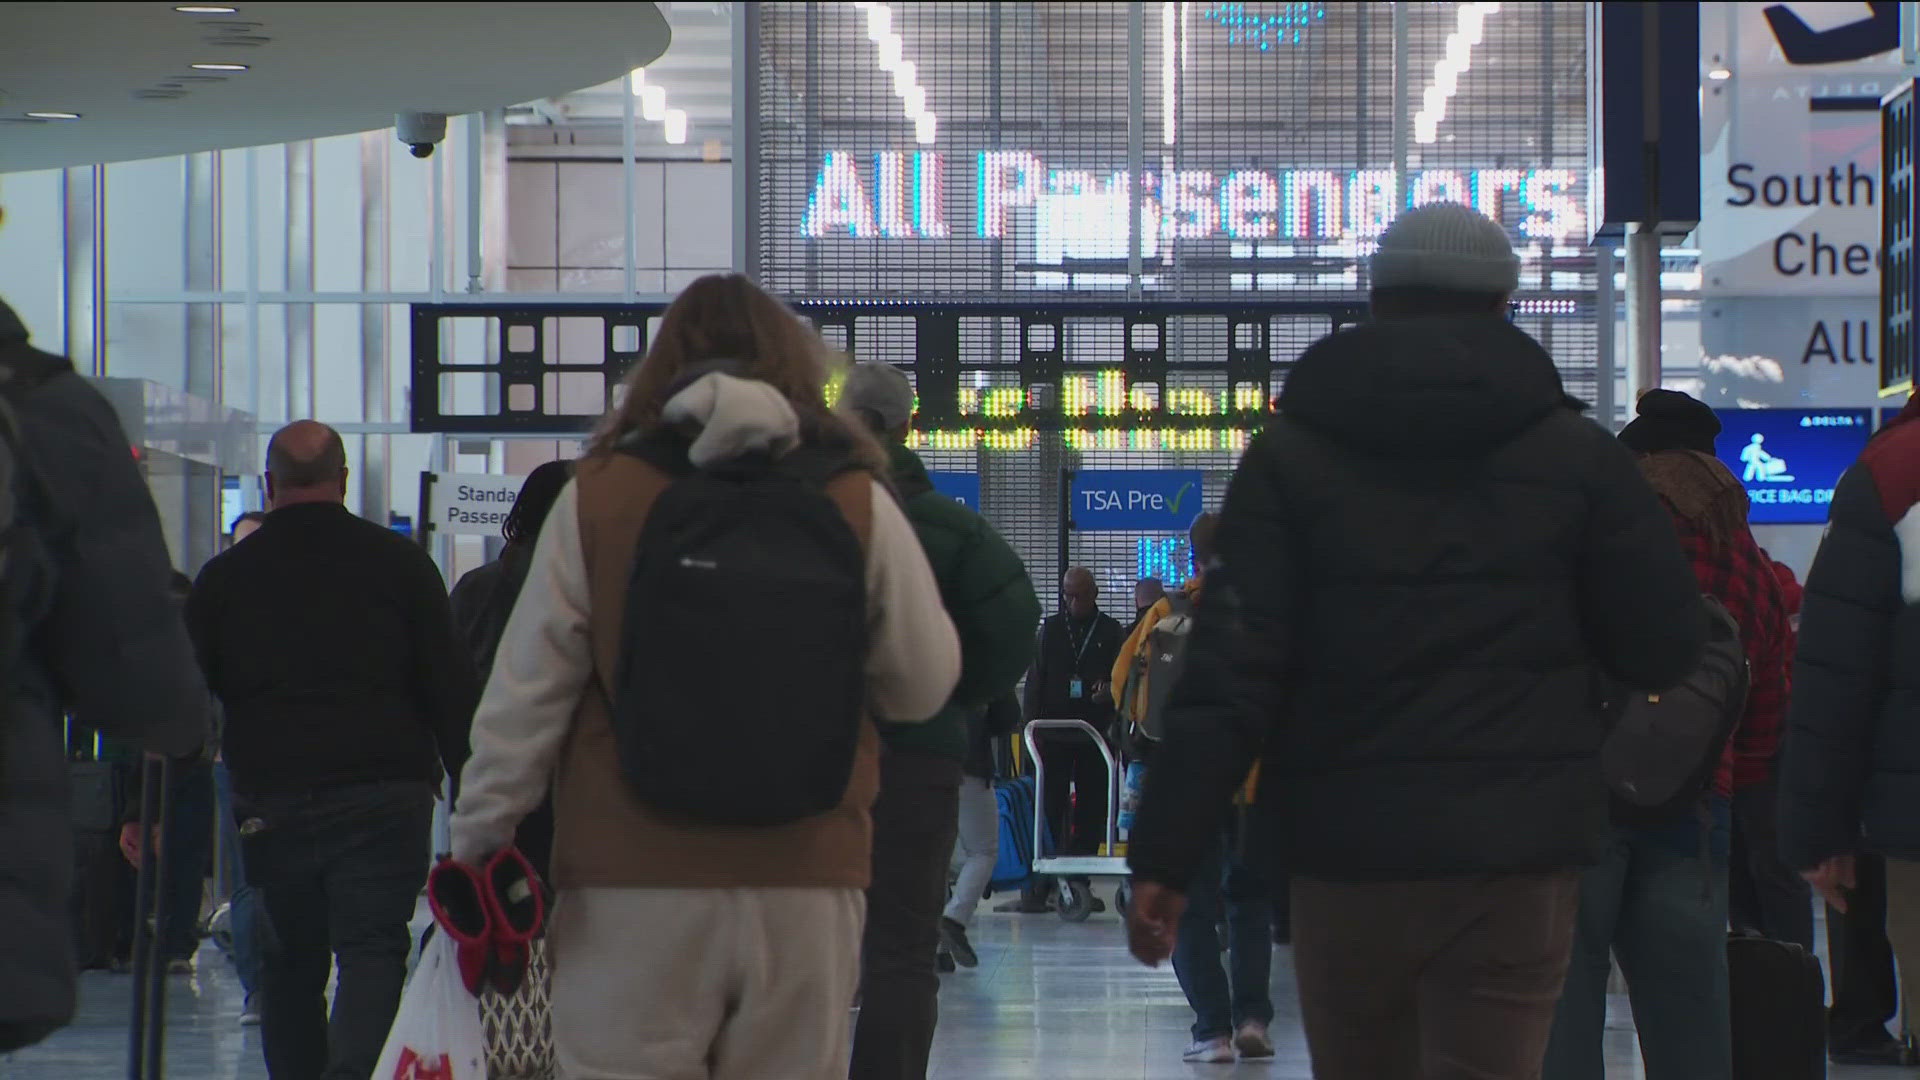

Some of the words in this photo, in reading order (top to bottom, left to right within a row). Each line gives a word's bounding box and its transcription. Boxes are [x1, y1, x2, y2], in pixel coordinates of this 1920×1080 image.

[800, 150, 951, 238] All
[1727, 163, 1875, 207] South
[1774, 232, 1881, 276] Che
[1802, 319, 1875, 365] All
[457, 485, 519, 503] Standa
[1081, 490, 1123, 511] TSA
[1128, 490, 1163, 511] Pre
[1748, 489, 1777, 503] ICE
[1779, 489, 1813, 503] BAG
